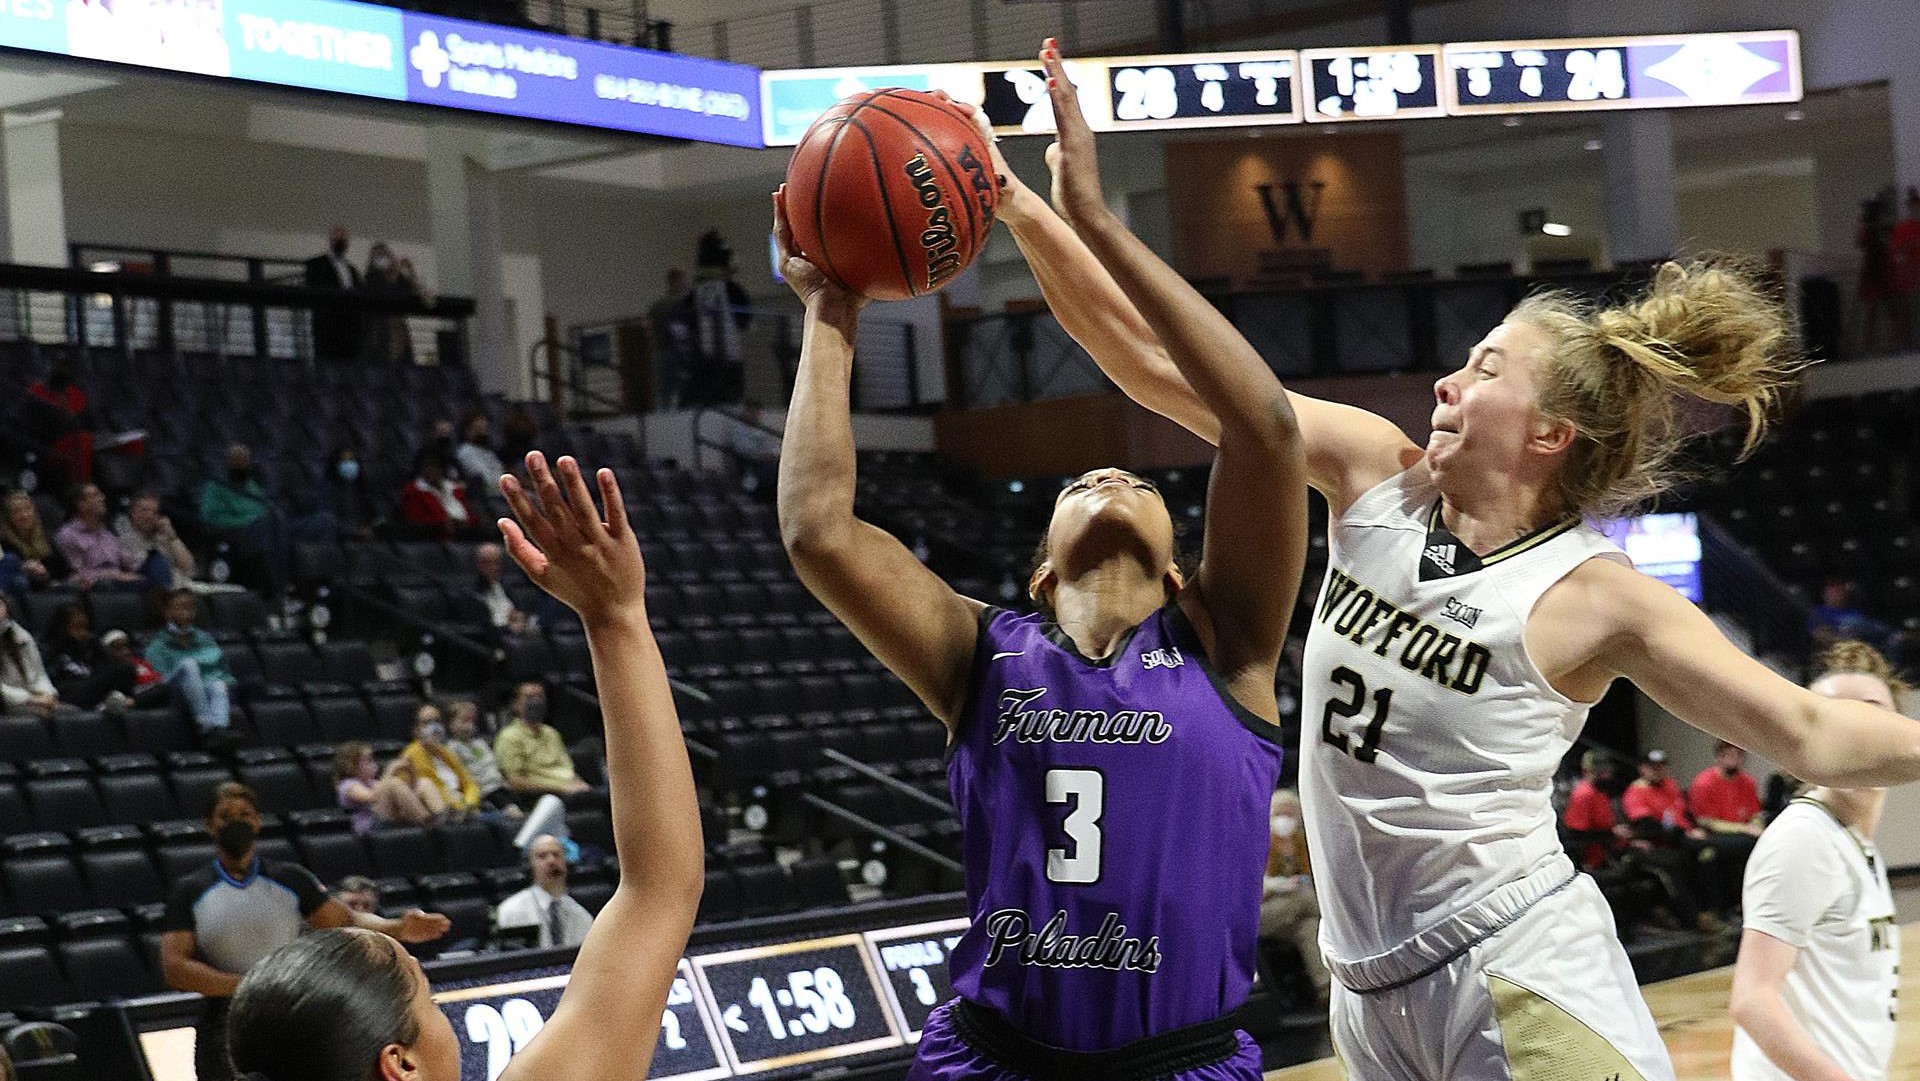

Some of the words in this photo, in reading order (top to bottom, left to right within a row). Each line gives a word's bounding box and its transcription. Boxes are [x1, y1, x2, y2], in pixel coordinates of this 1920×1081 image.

[238, 13, 393, 70] TOGETHER
[1565, 50, 1625, 100] 24
[904, 151, 961, 289] Wilson
[1254, 181, 1326, 243] W
[1318, 567, 1492, 697] WOFFORD
[992, 687, 1173, 746] Furman
[1322, 665, 1394, 764] 21
[1045, 768, 1105, 884] 3
[748, 966, 857, 1041] 1:58
[909, 967, 938, 1006] 3
